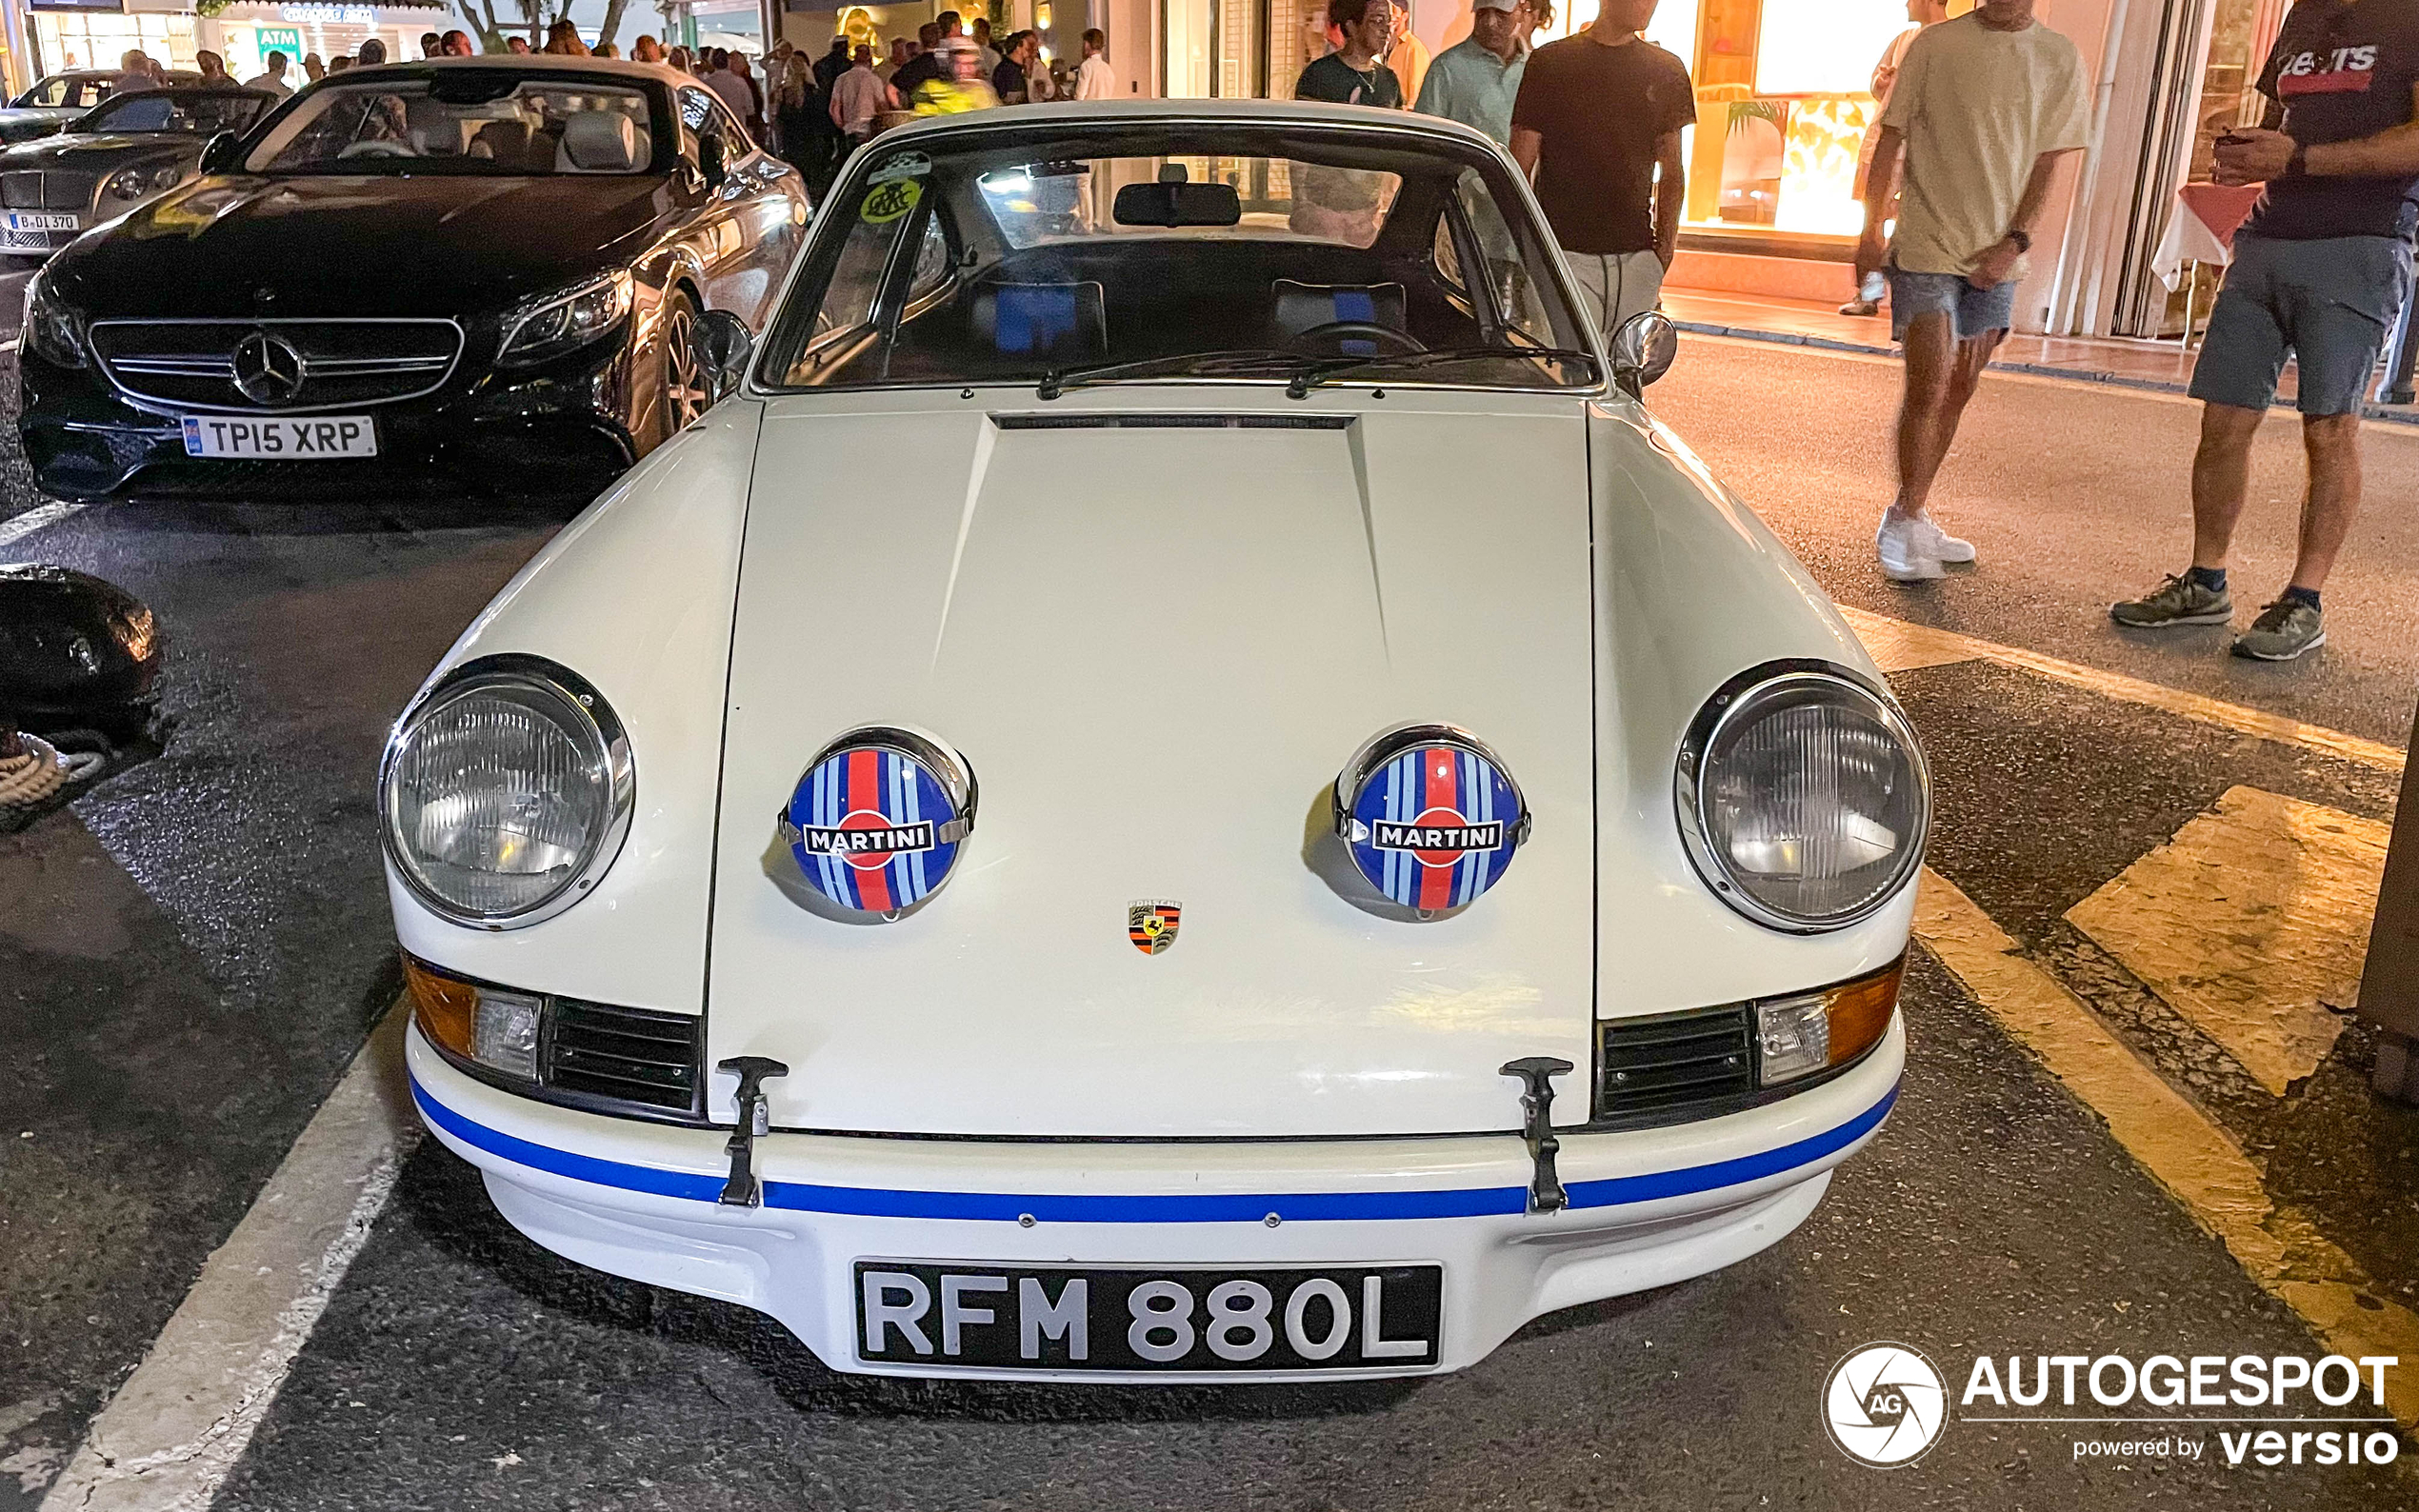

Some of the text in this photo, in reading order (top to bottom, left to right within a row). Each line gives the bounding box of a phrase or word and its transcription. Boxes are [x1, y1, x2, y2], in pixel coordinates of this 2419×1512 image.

[260, 30, 296, 45] ATM
[51, 216, 73, 228] 370
[210, 422, 360, 452] TP15 XRP
[810, 827, 925, 850] MARTINI
[1382, 826, 1495, 847] MARTINI
[1129, 899, 1182, 909] PORSCHE
[863, 1271, 1429, 1362] RFM 880L
